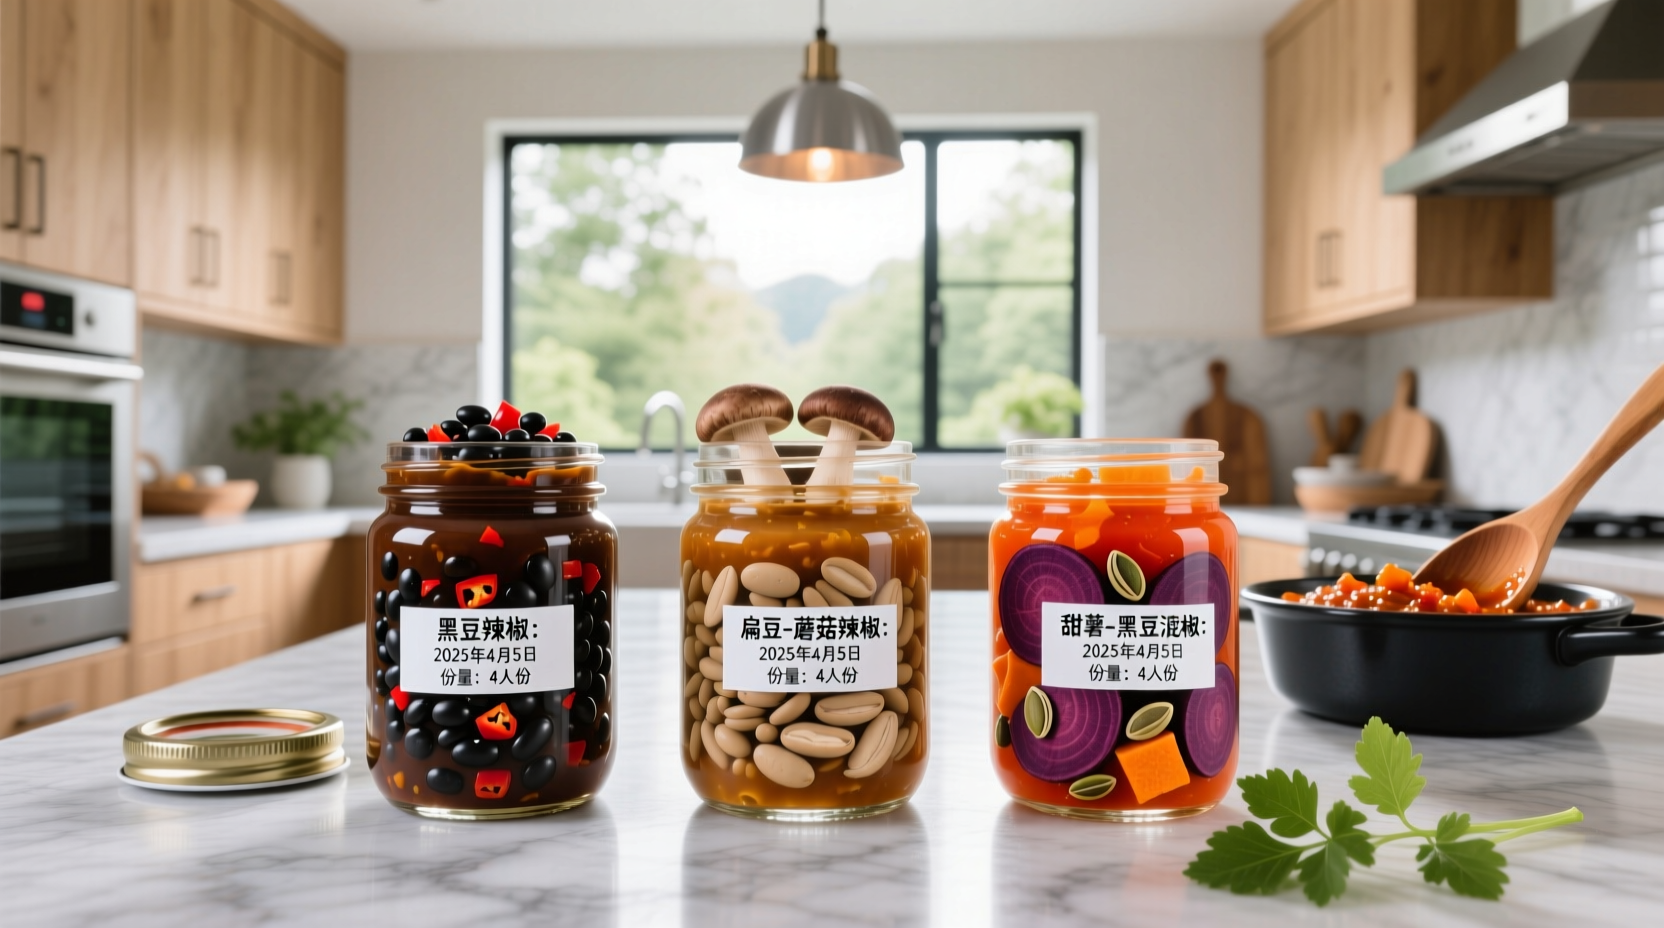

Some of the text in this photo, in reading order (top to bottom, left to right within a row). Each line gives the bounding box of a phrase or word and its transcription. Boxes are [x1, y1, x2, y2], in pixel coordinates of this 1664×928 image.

[433, 646, 537, 665] 2025年4月5日
[758, 645, 861, 663] 2025年4月5日
[1082, 642, 1184, 660] 2025年4月5日
